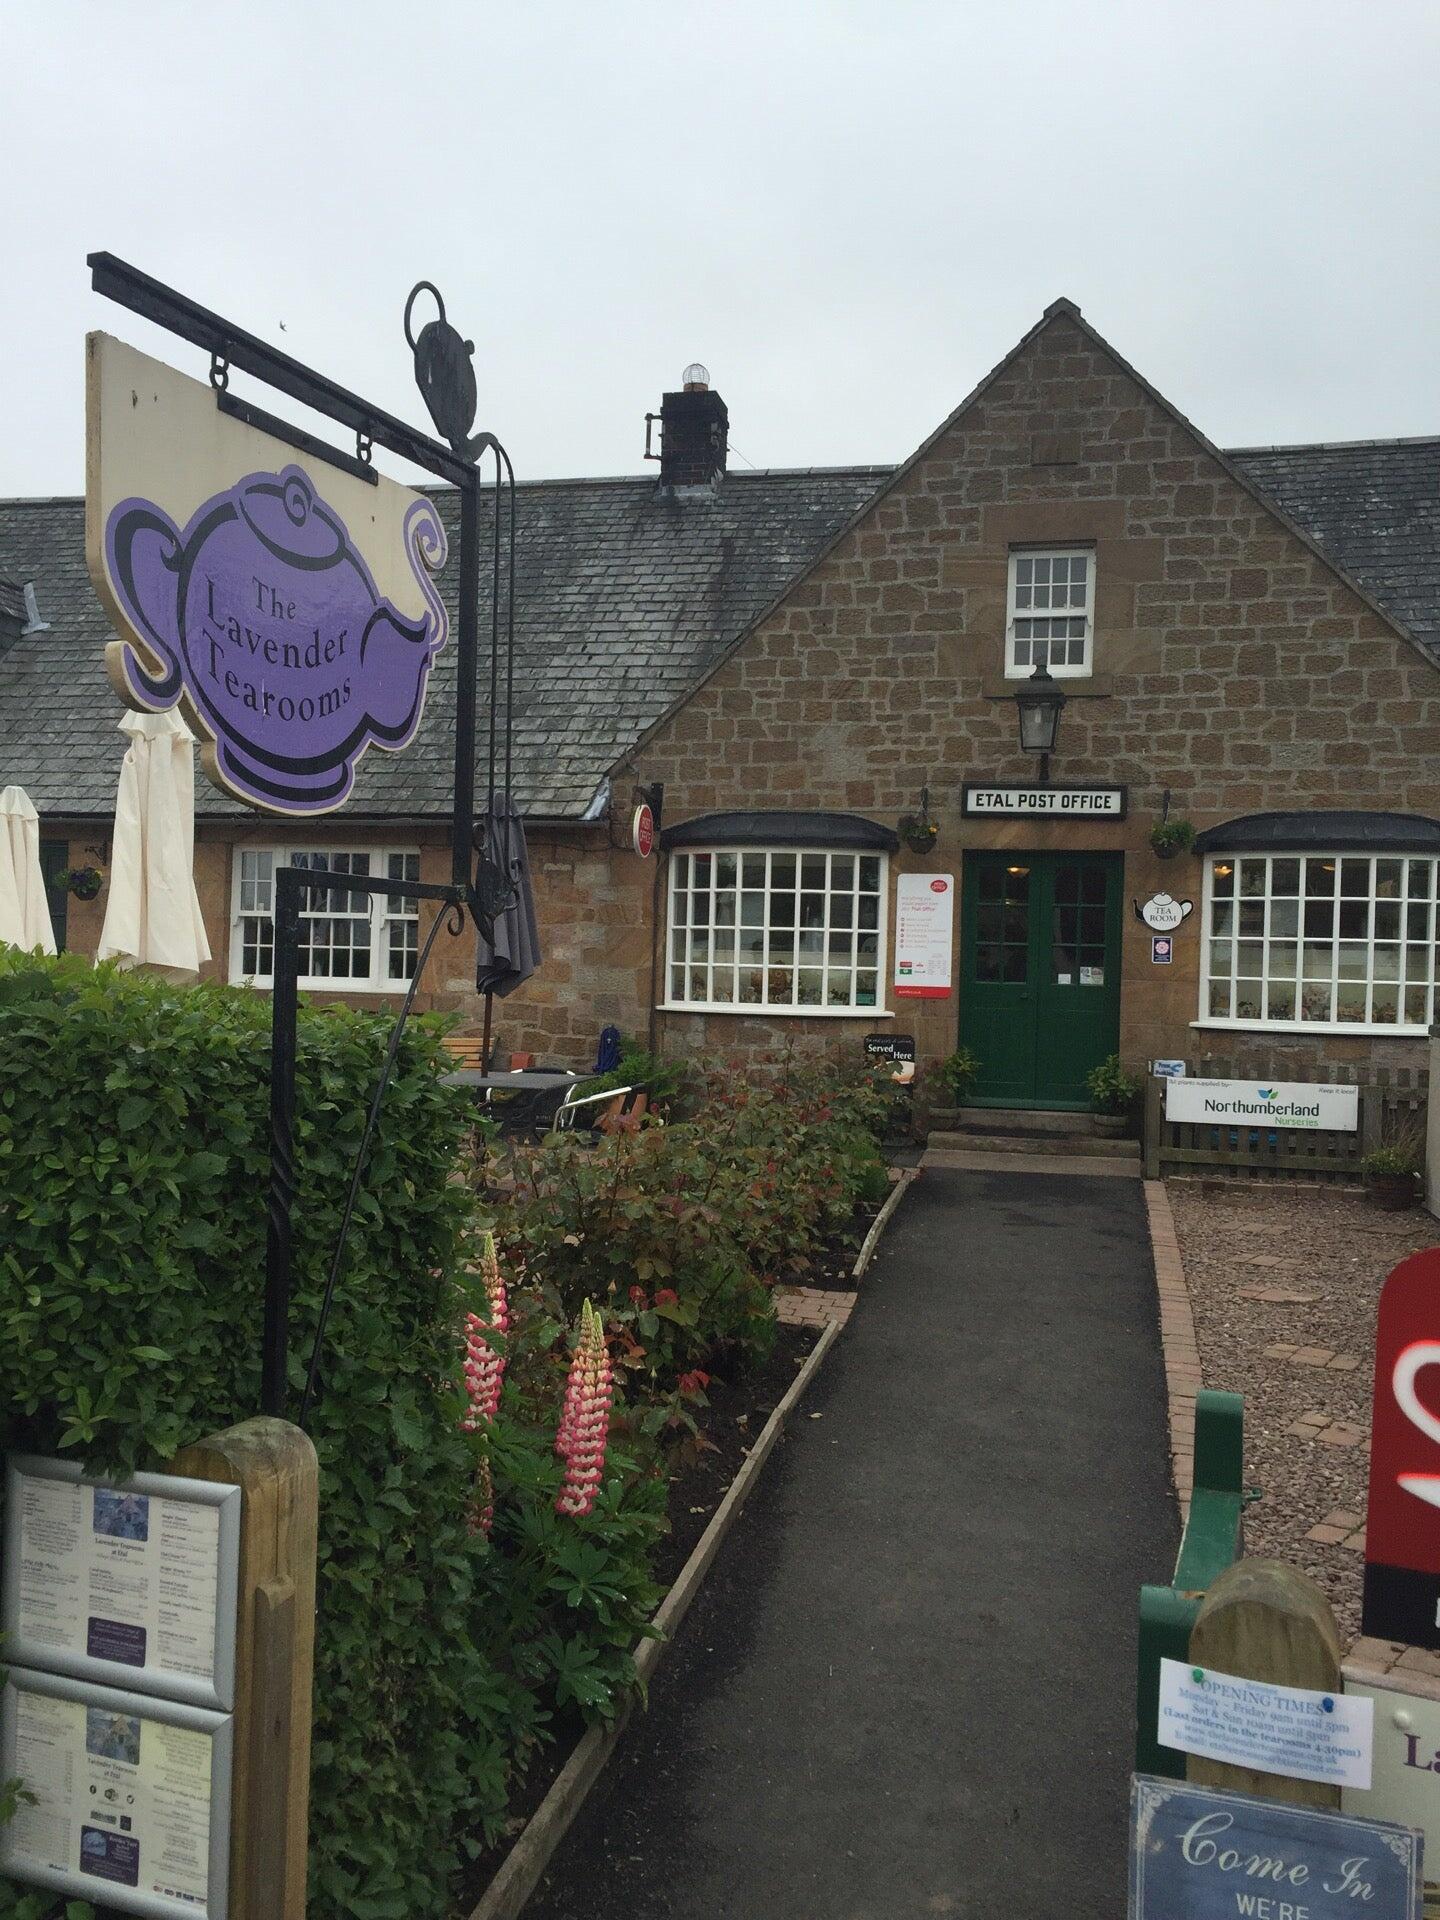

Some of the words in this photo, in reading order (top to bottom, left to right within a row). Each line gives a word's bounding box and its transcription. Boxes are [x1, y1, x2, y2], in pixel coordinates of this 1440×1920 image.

[251, 575, 297, 621] The
[205, 575, 349, 669] Lavender
[202, 628, 351, 722] Tearooms
[975, 793, 1014, 807] ETAL
[1018, 794, 1056, 808] POST
[1061, 795, 1112, 809] OFFICE
[868, 1043, 894, 1052] Served
[893, 1051, 912, 1060] Here
[1204, 1099, 1320, 1117] Northumberland
[1275, 1116, 1319, 1127] Nurseries
[1178, 1687, 1218, 1706] Monday
[1233, 1702, 1265, 1718] Friday
[1270, 1712, 1294, 1724] 9am
[1297, 1717, 1322, 1729] until
[1325, 1722, 1350, 1733] 5pm
[1200, 1680, 1271, 1707] OPENING
[1273, 1696, 1325, 1716] TIMES
[1163, 1706, 1189, 1720] (Last
[1191, 1716, 1226, 1731] orders
[1228, 1723, 1239, 1735] in
[1241, 1727, 1258, 1739] the
[1260, 1732, 1312, 1750] tearooms
[1192, 1703, 1208, 1716] Sat
[1211, 1709, 1219, 1718] &
[1222, 1712, 1243, 1725] Sun
[1246, 1719, 1275, 1732] 10am
[1277, 1725, 1304, 1738] until
[1305, 1730, 1331, 1742] 5pm
[1175, 1812, 1310, 1886] Come
[1322, 1857, 1375, 1901] In
[1236, 1892, 1310, 1920] WE'RE
